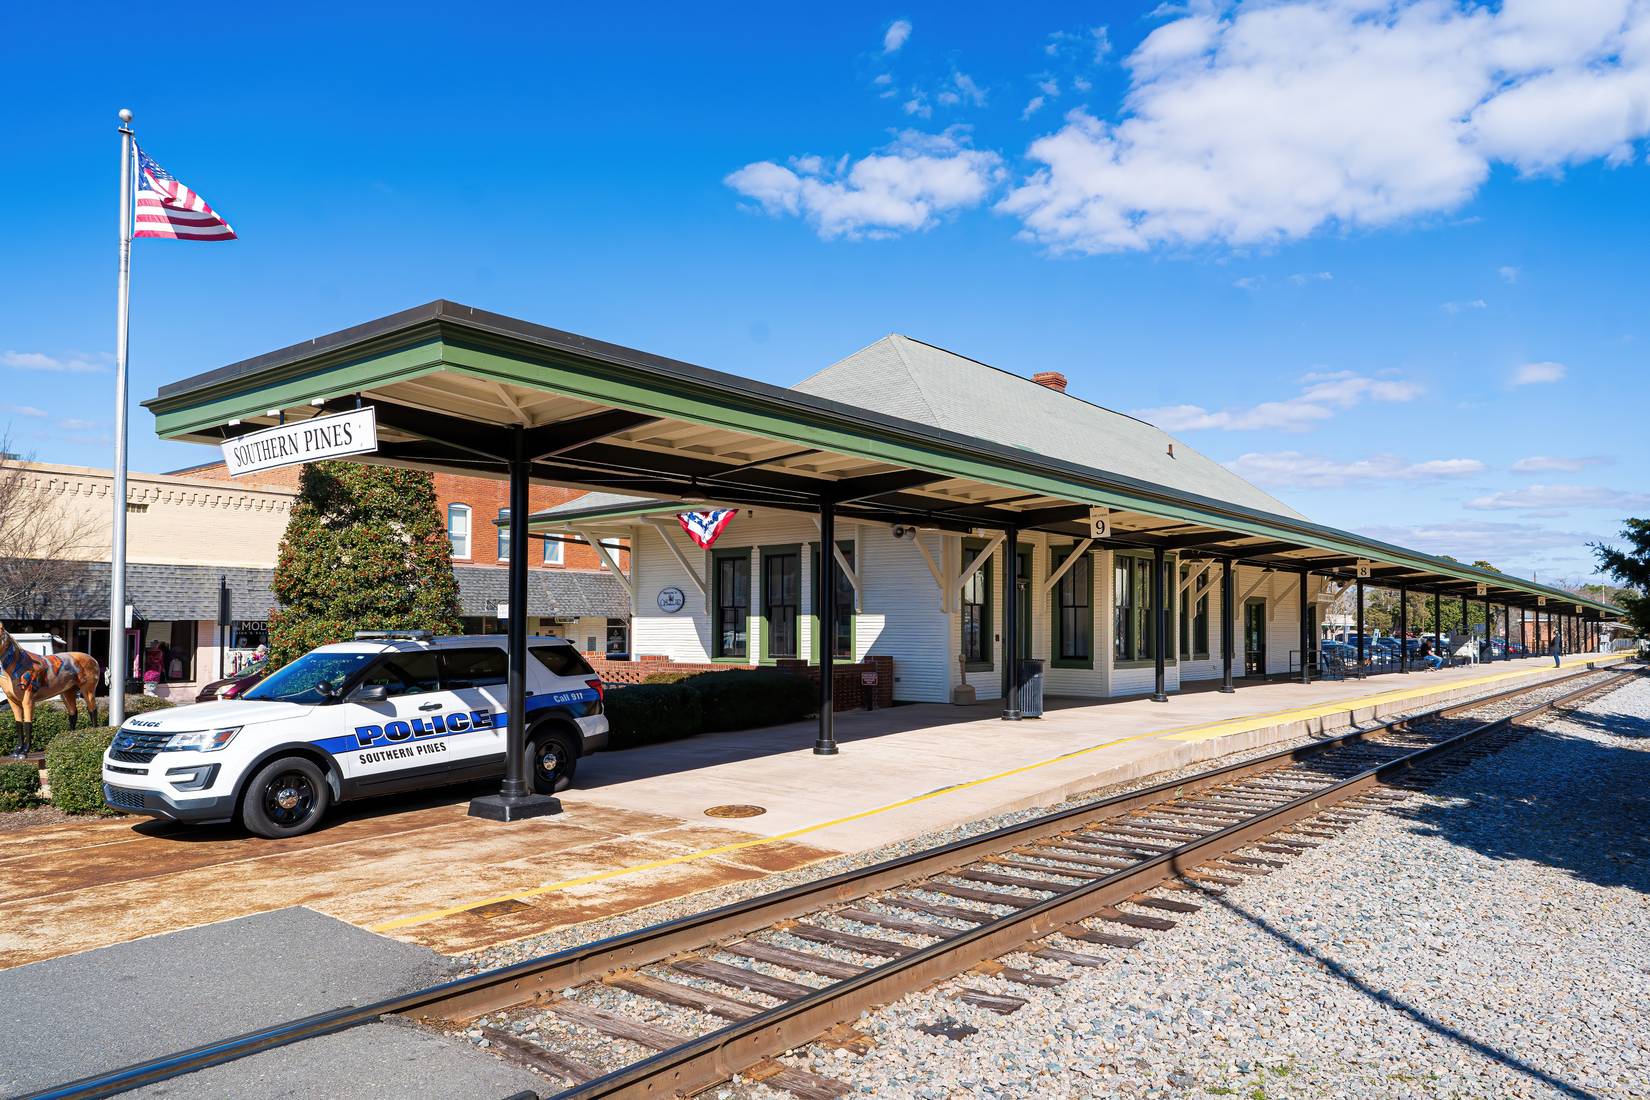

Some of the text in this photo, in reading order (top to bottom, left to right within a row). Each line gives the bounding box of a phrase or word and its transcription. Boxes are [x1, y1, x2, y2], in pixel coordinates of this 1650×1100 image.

[233, 422, 352, 467] SOUTHERN PINES
[1095, 519, 1105, 535] 9
[1360, 567, 1367, 576] 8
[553, 692, 584, 703] Call 911
[355, 709, 493, 747] POLICE
[359, 742, 447, 765] SOUTHERN PINES
